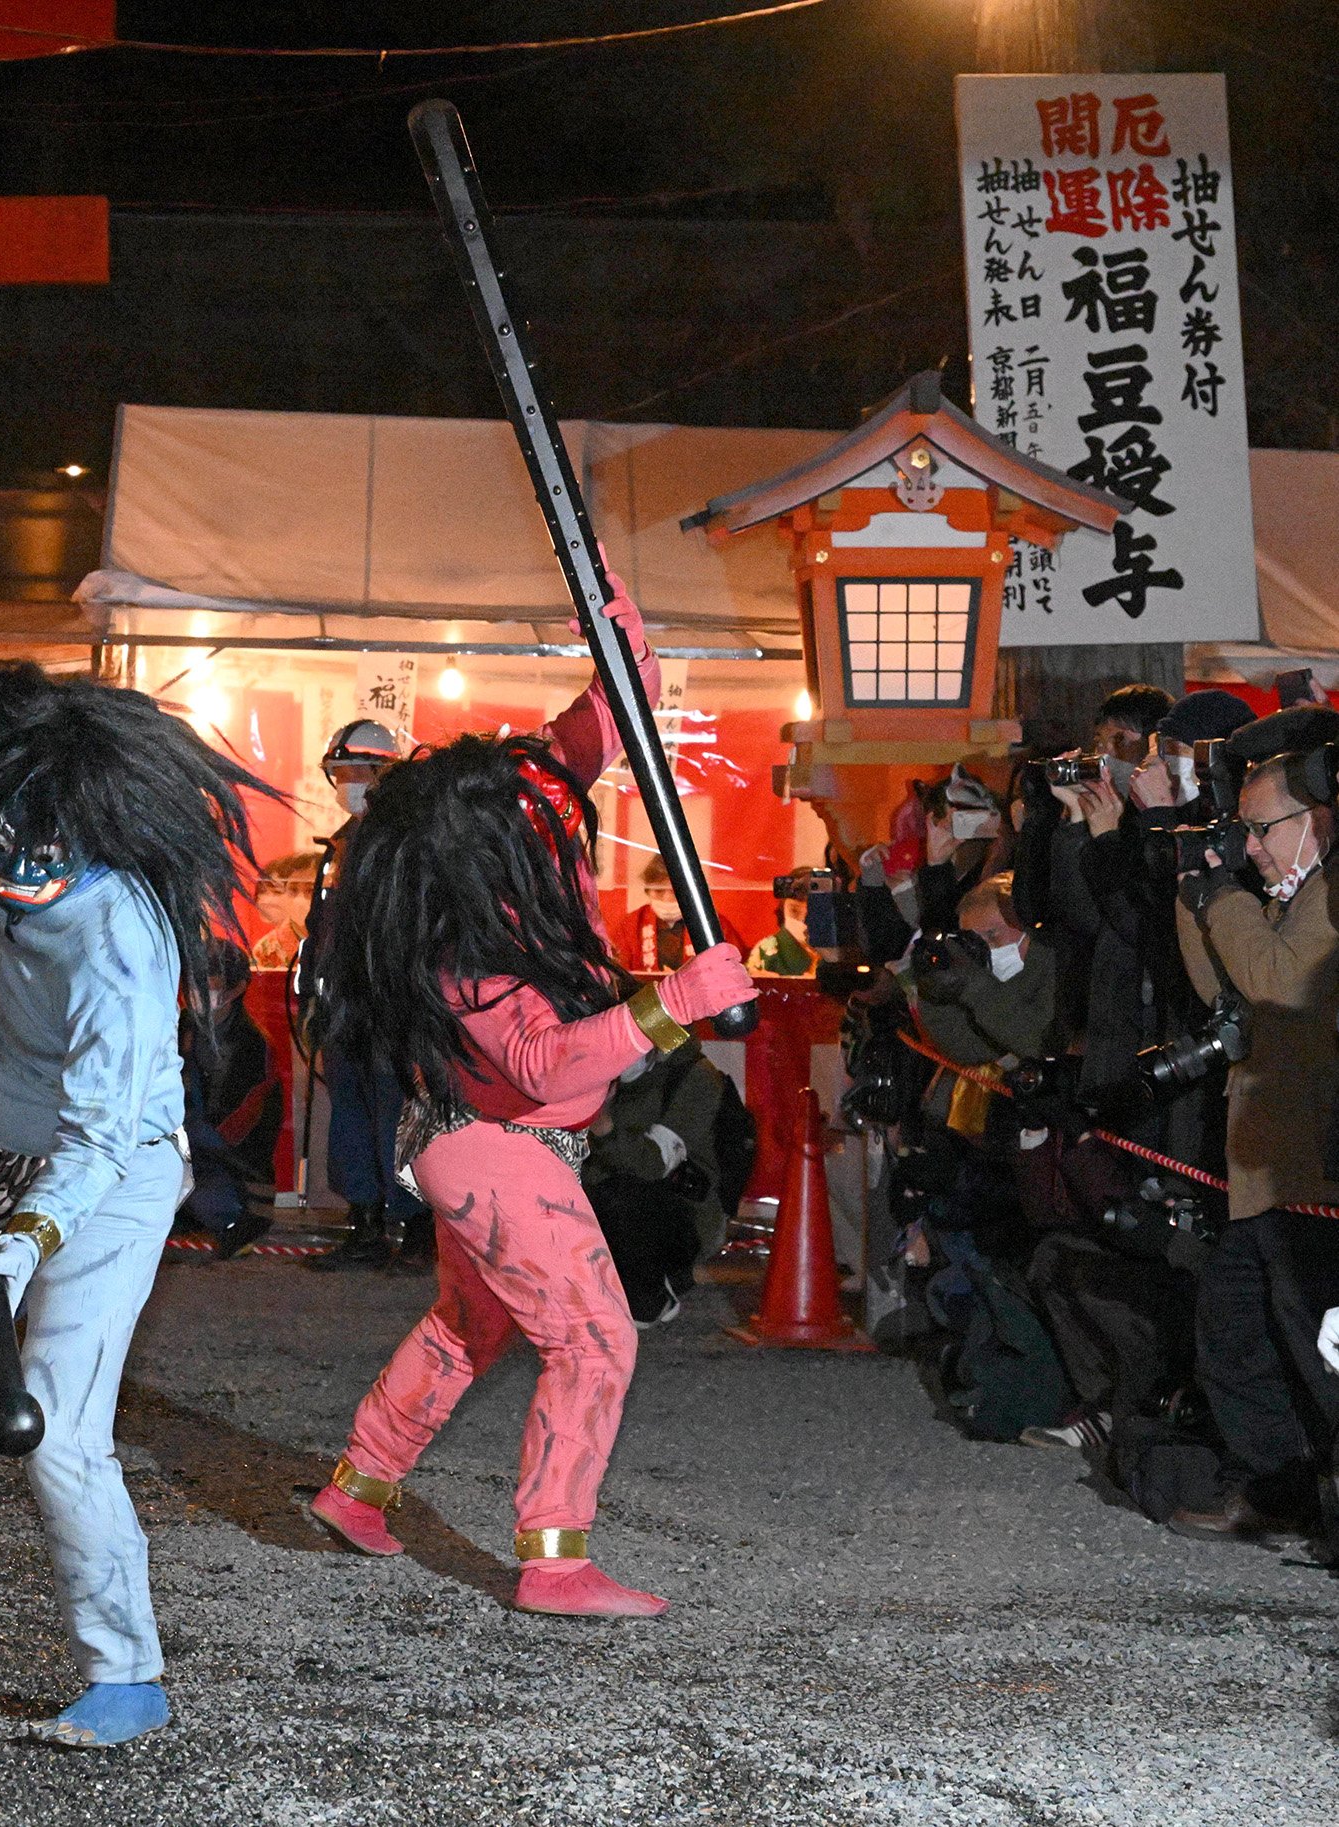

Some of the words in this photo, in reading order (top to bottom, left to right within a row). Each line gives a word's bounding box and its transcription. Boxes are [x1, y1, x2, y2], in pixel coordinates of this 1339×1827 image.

[1012, 158, 1046, 318] 抽せん日
[1035, 93, 1109, 238] 開運
[1106, 94, 1171, 232] 厄除
[977, 157, 1018, 327] 抽せん発表
[1172, 153, 1226, 417] 抽せん券付
[1062, 246, 1184, 619] 福豆授与
[1028, 543, 1056, 614] 頭にて
[369, 675, 396, 710] 福
